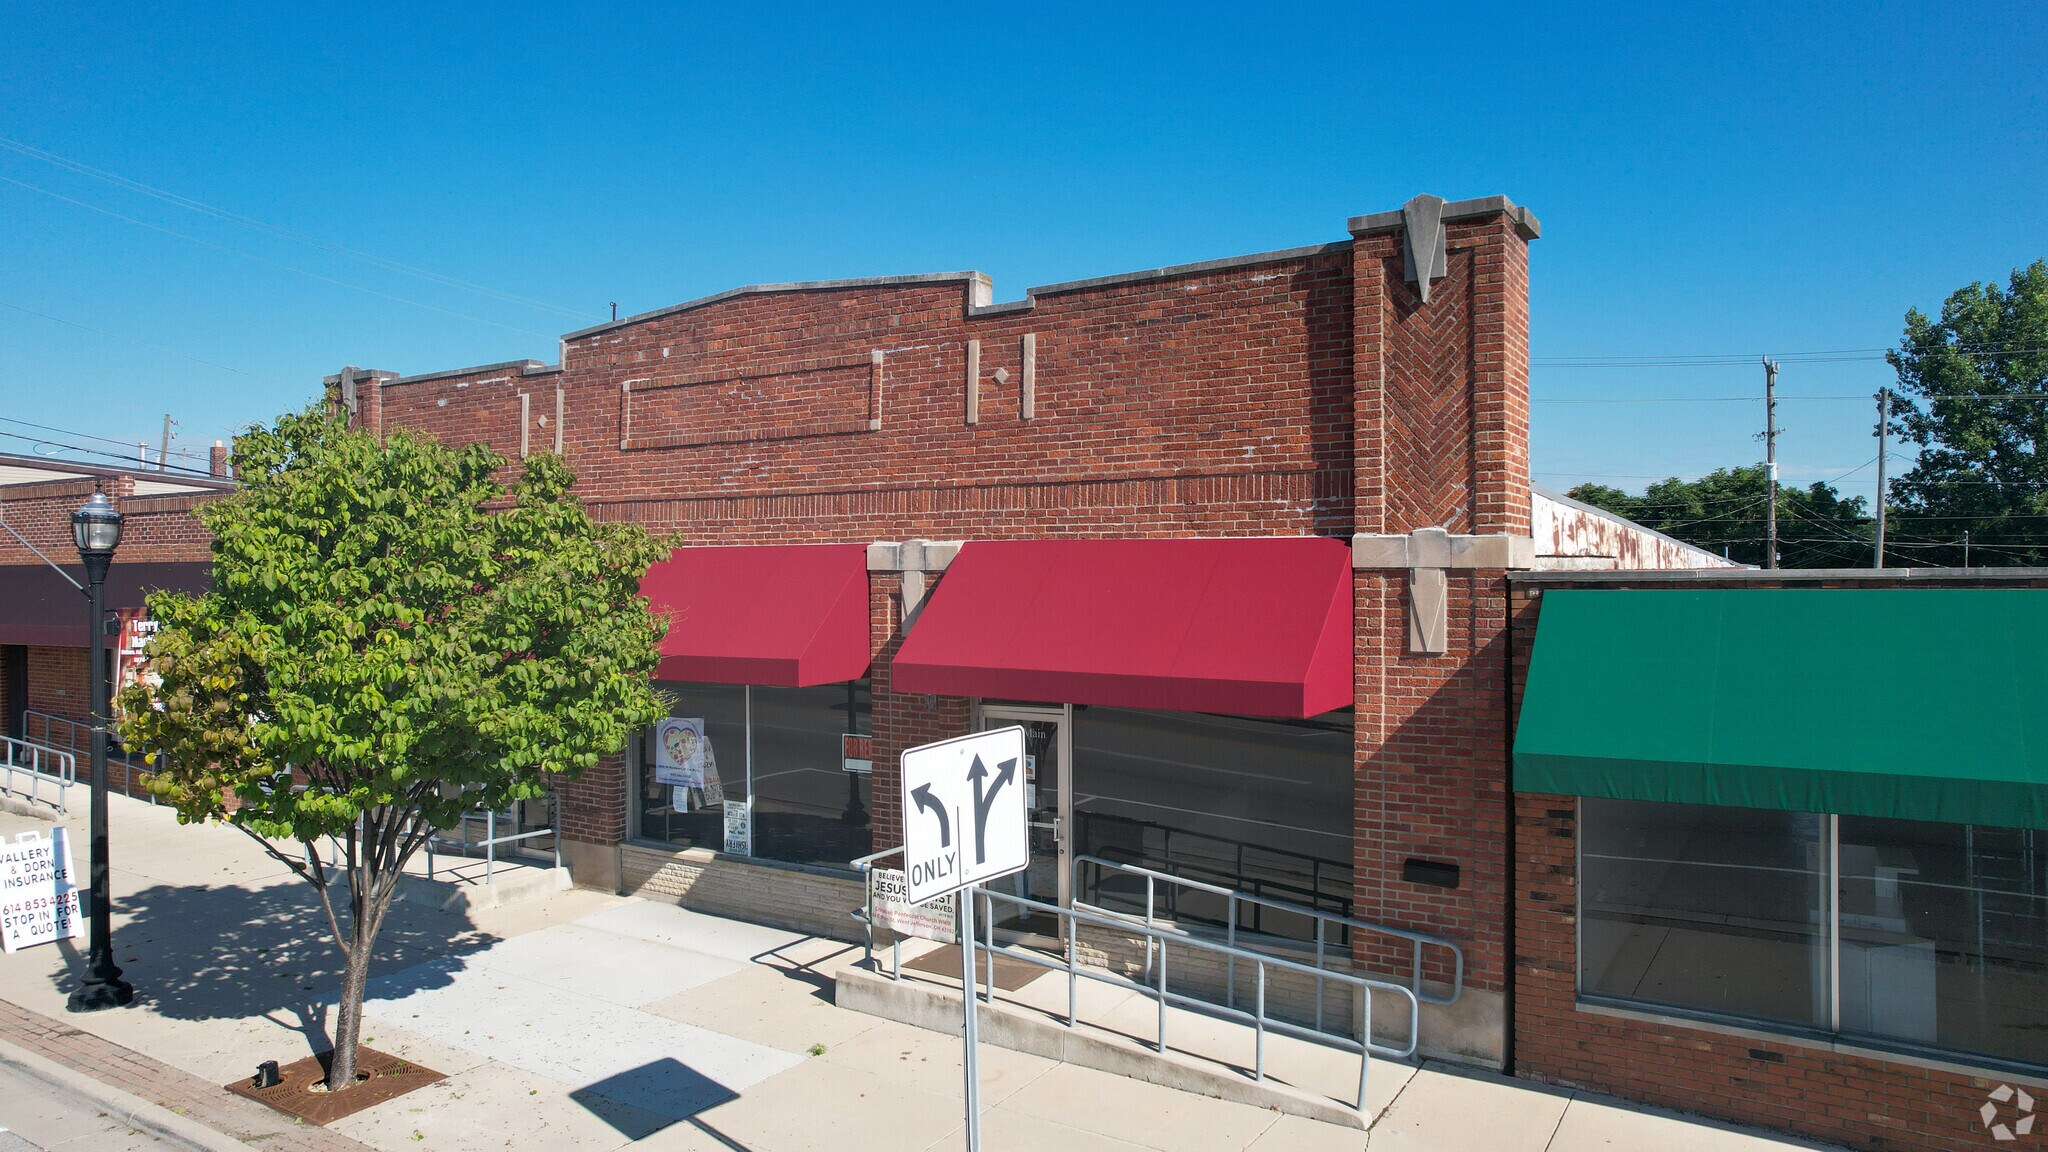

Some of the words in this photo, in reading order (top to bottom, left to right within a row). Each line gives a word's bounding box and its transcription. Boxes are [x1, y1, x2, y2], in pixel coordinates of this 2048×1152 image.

[132, 619, 159, 632] Terry
[844, 736, 858, 758] FOR
[11, 866, 17, 875] &
[24, 859, 55, 873] DORN
[912, 851, 956, 887] ONLY
[3, 868, 68, 889] INSURANCE
[878, 871, 904, 883] BELIEVE
[875, 880, 907, 896] JESUS
[872, 891, 885, 901] AND
[885, 895, 901, 903] YOU
[2, 905, 21, 915] 614
[929, 903, 955, 914] SAVED.
[4, 913, 35, 928] STOP
[39, 910, 50, 920] IN
[56, 904, 78, 918] FOR
[897, 917, 910, 925] West
[920, 915, 938, 924] Church
[13, 929, 20, 939] A
[30, 918, 72, 936] QUOTE!
